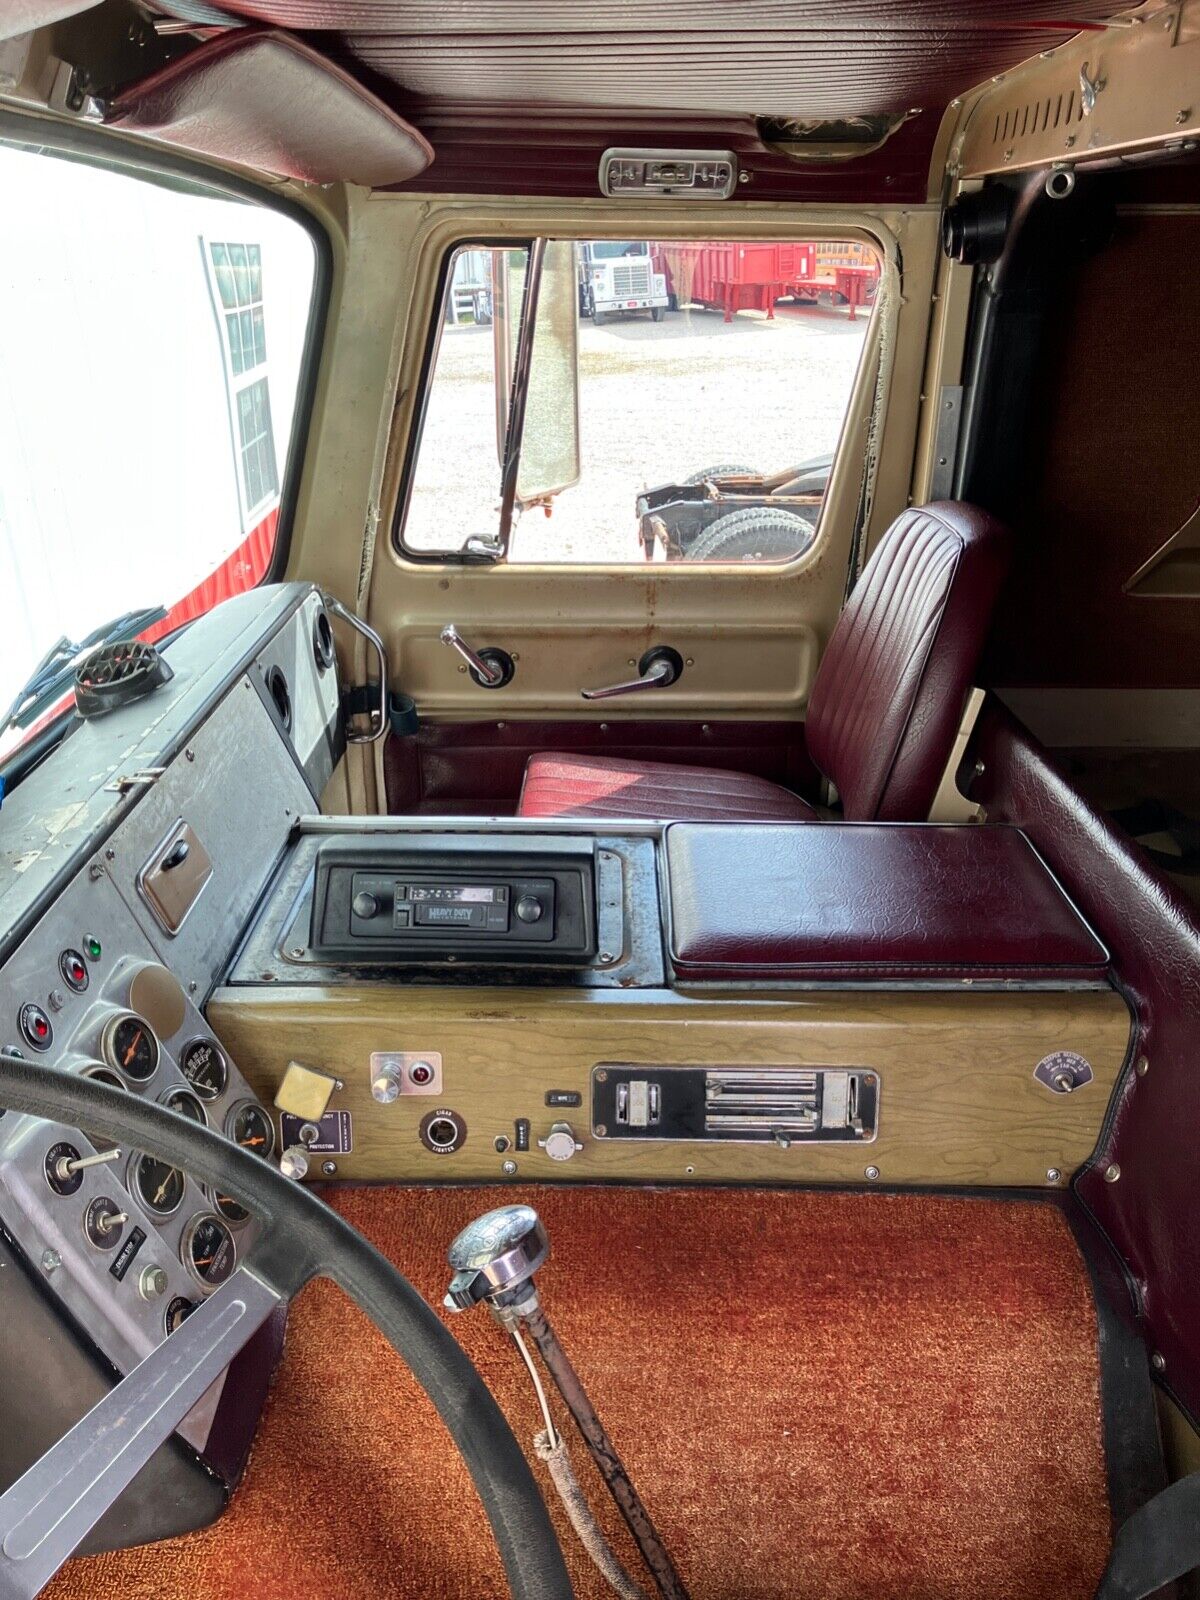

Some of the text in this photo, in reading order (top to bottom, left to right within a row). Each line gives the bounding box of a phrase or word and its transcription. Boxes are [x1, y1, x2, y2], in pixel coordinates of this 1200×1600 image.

[428, 907, 473, 920] HEAVY DUTY
[432, 1145, 456, 1153] LIGHTER
[209, 1239, 230, 1276] TRANSMISSION
[219, 1255, 228, 1271] TEMP
